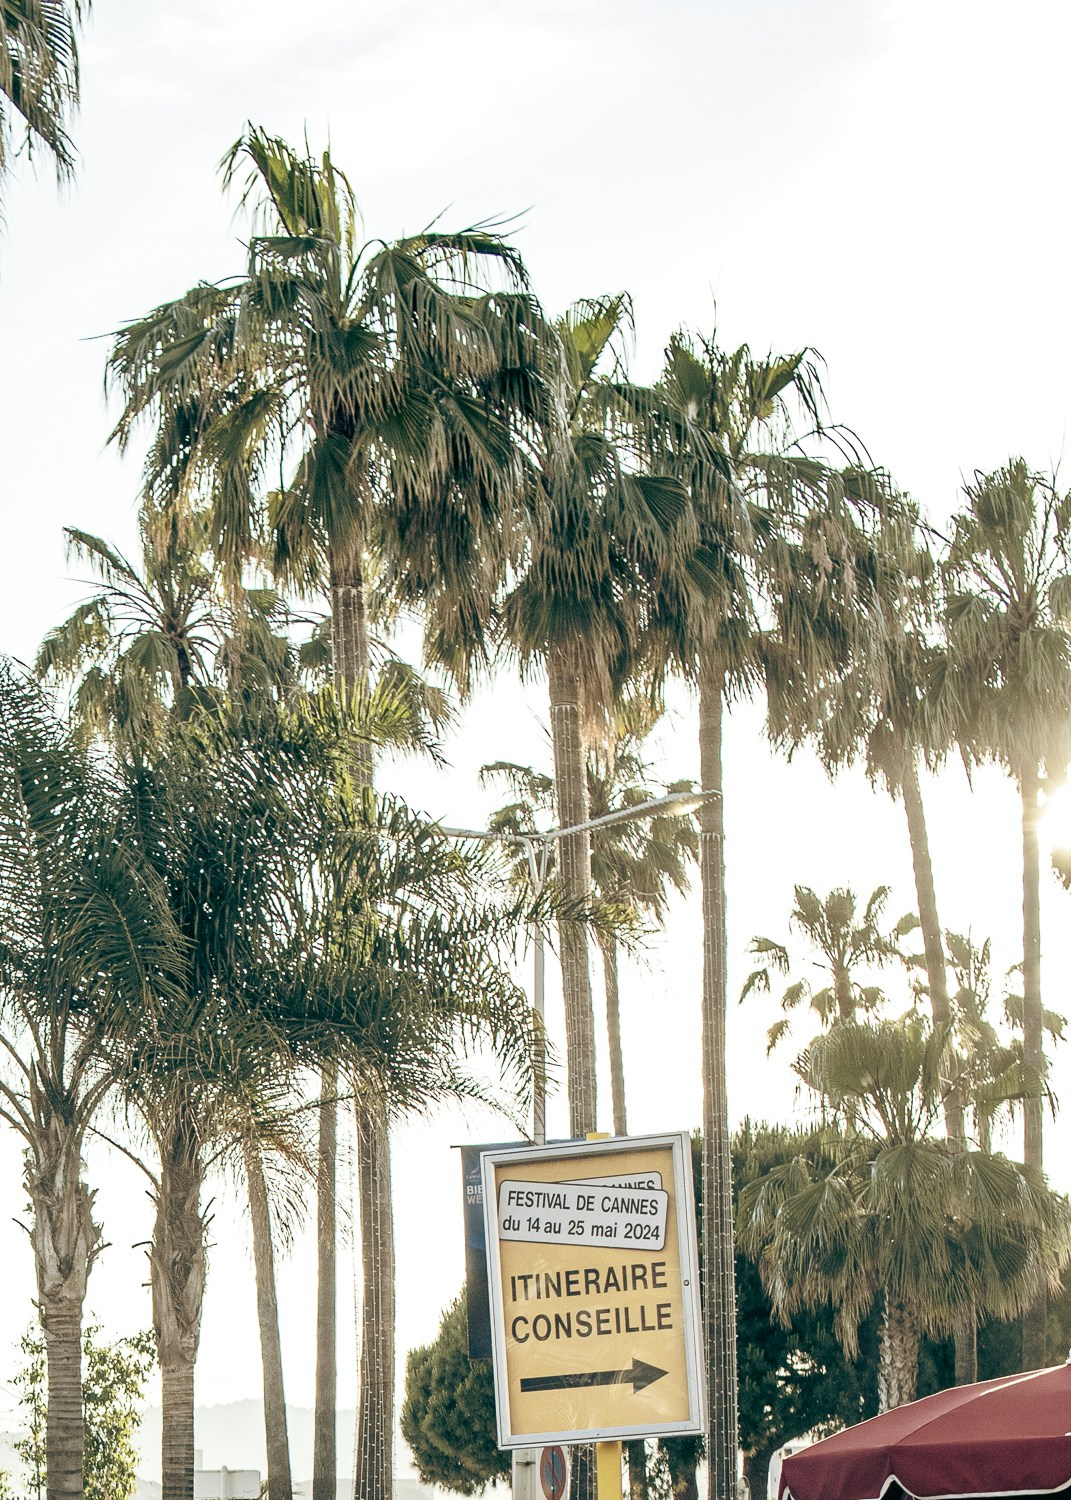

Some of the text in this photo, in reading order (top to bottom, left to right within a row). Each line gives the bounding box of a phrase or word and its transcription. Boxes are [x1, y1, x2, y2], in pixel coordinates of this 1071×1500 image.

[508, 1190, 658, 1216] FESTIVAL DE CANNES
[502, 1215, 660, 1240] du 14 au 25 mai 2024
[511, 1262, 667, 1302] ITINERAIRE
[511, 1303, 673, 1343] CONSEILLE
